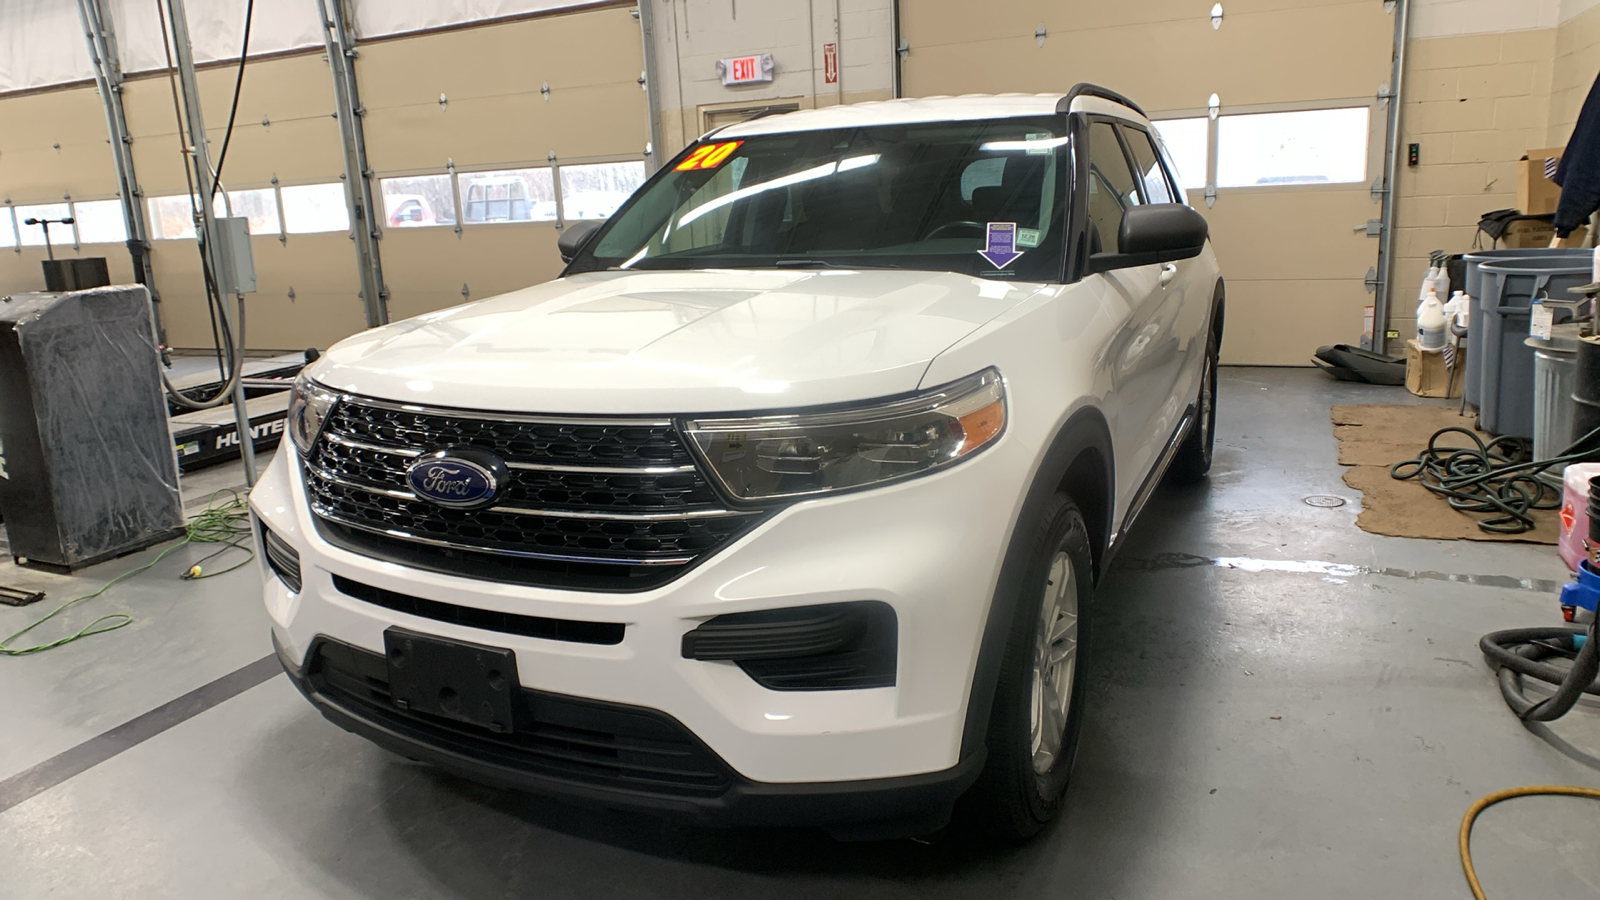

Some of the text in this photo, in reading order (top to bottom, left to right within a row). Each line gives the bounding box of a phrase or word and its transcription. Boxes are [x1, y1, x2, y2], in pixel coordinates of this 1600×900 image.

[732, 58, 755, 81] EXIT
[675, 142, 737, 171] 20
[423, 466, 472, 496] Ford
